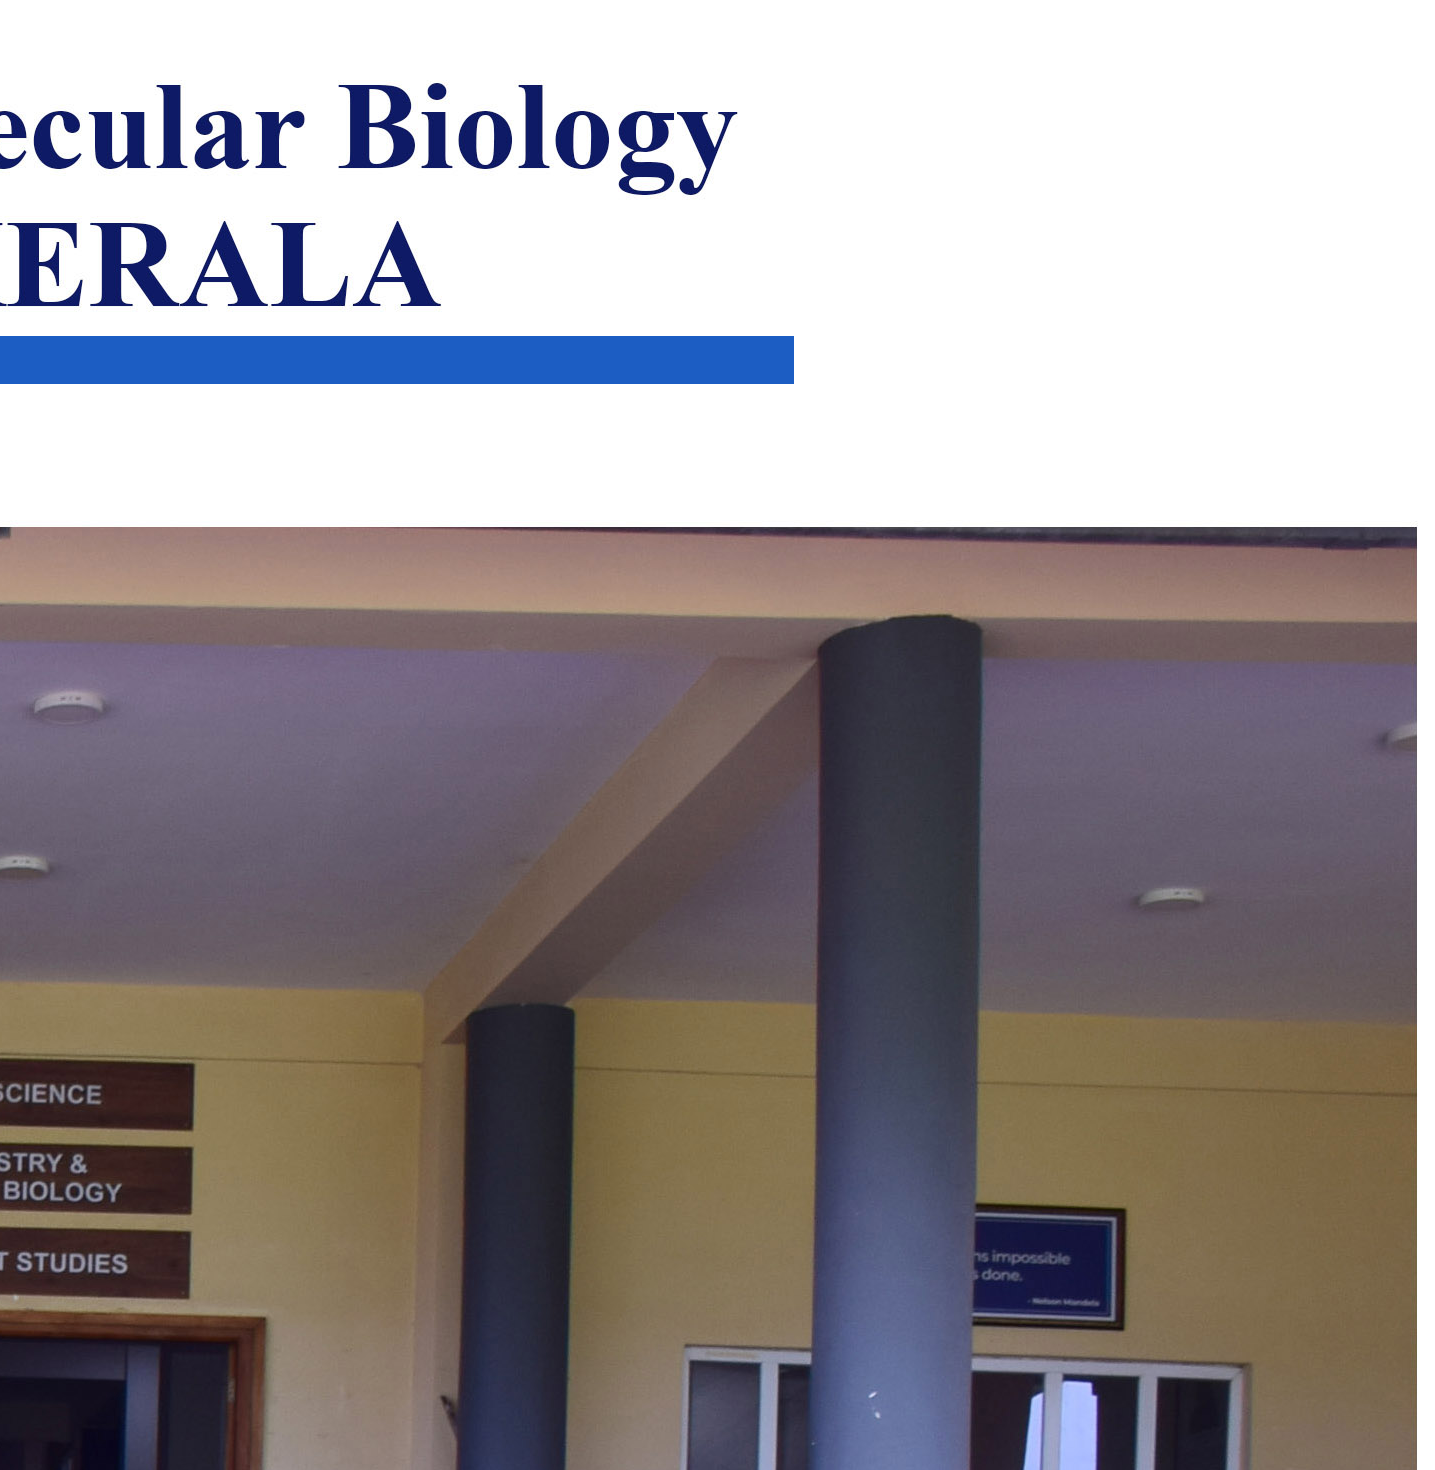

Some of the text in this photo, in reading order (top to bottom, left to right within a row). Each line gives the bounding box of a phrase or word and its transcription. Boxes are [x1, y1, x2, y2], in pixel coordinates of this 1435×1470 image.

[70, 1153, 88, 1175] &
[3, 1179, 123, 1203] BIOLOGY
[17, 1251, 129, 1275] STUDIES
[992, 1249, 1072, 1266] impossible
[981, 1268, 1024, 1282] done.
